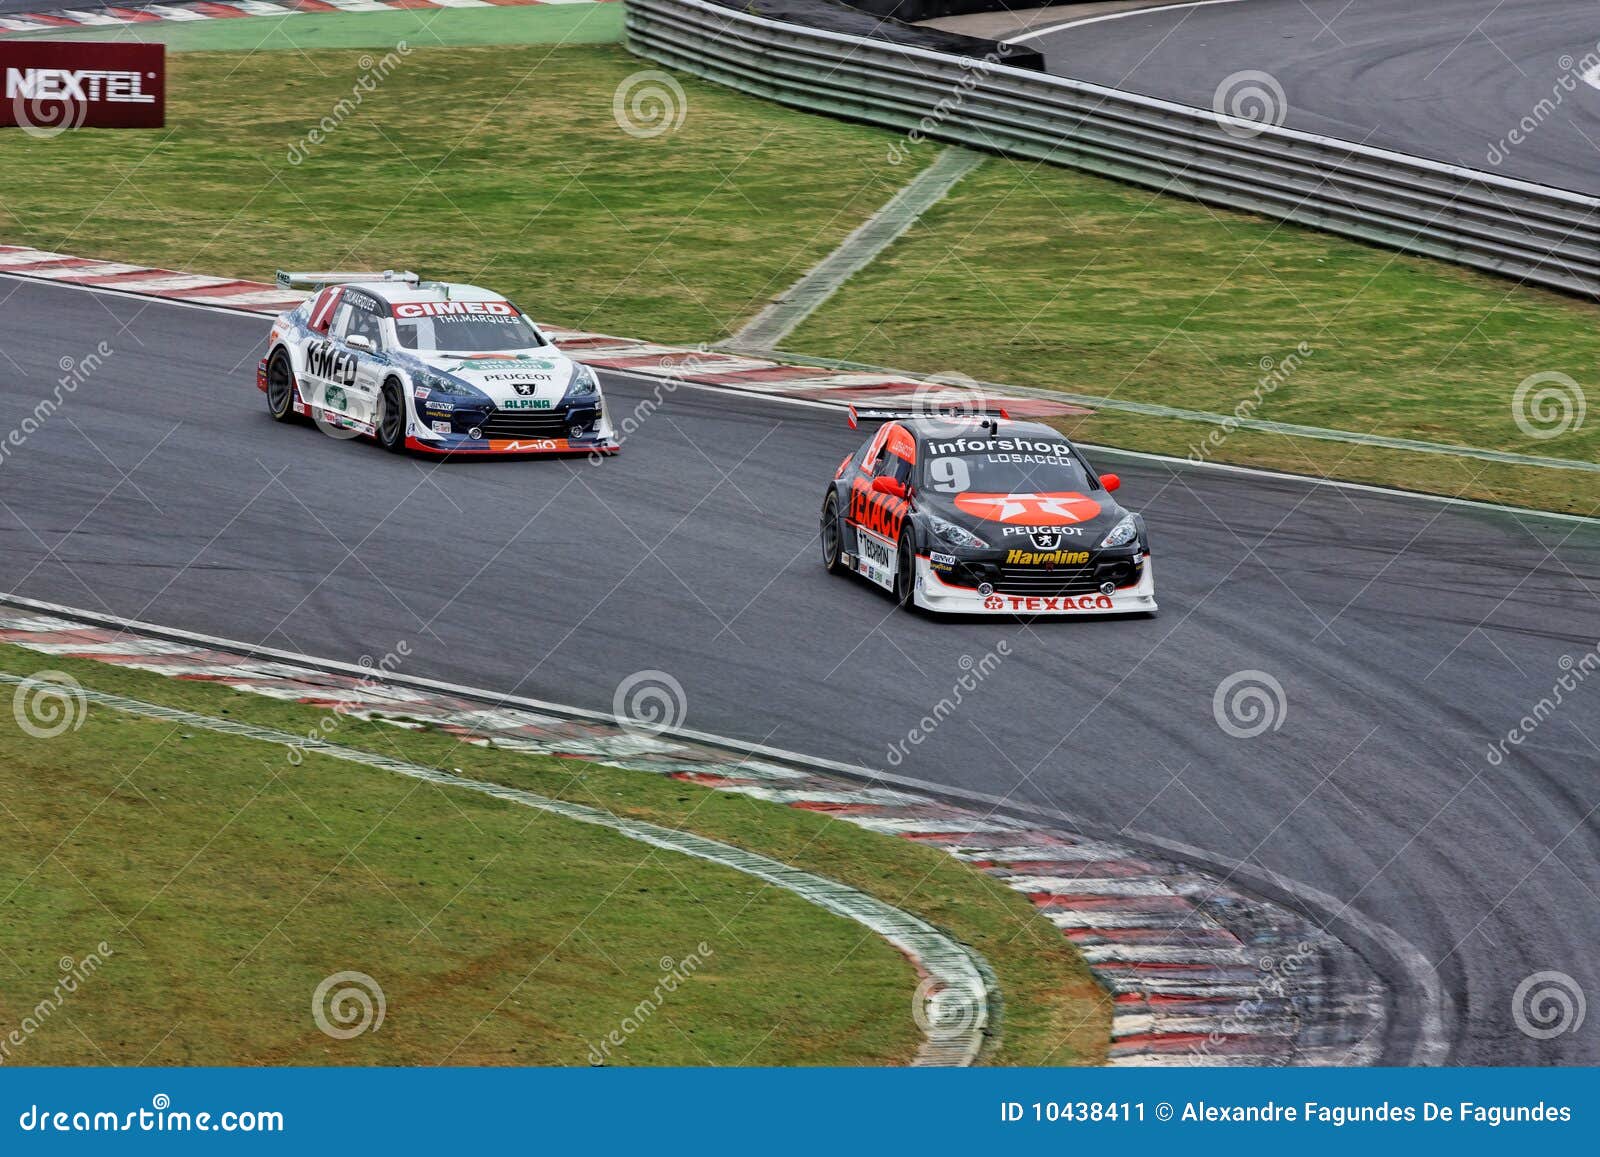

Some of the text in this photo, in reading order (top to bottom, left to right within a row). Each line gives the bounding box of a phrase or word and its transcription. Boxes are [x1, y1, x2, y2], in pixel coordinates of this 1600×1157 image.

[6, 68, 156, 103] NEXTEL
[396, 302, 512, 317] CIMED
[437, 314, 520, 325] THI.MARQUES
[484, 373, 553, 382] PEUGEOT
[505, 400, 550, 409] ALPINA
[929, 438, 1070, 456] inforshop
[987, 453, 1071, 467] LOSACCO
[930, 456, 971, 493] 9
[850, 478, 910, 542] TEXACO
[1002, 526, 1085, 537] PEUGEOT
[1006, 549, 1090, 565] Havoline
[1007, 595, 1114, 611] TEXACO
